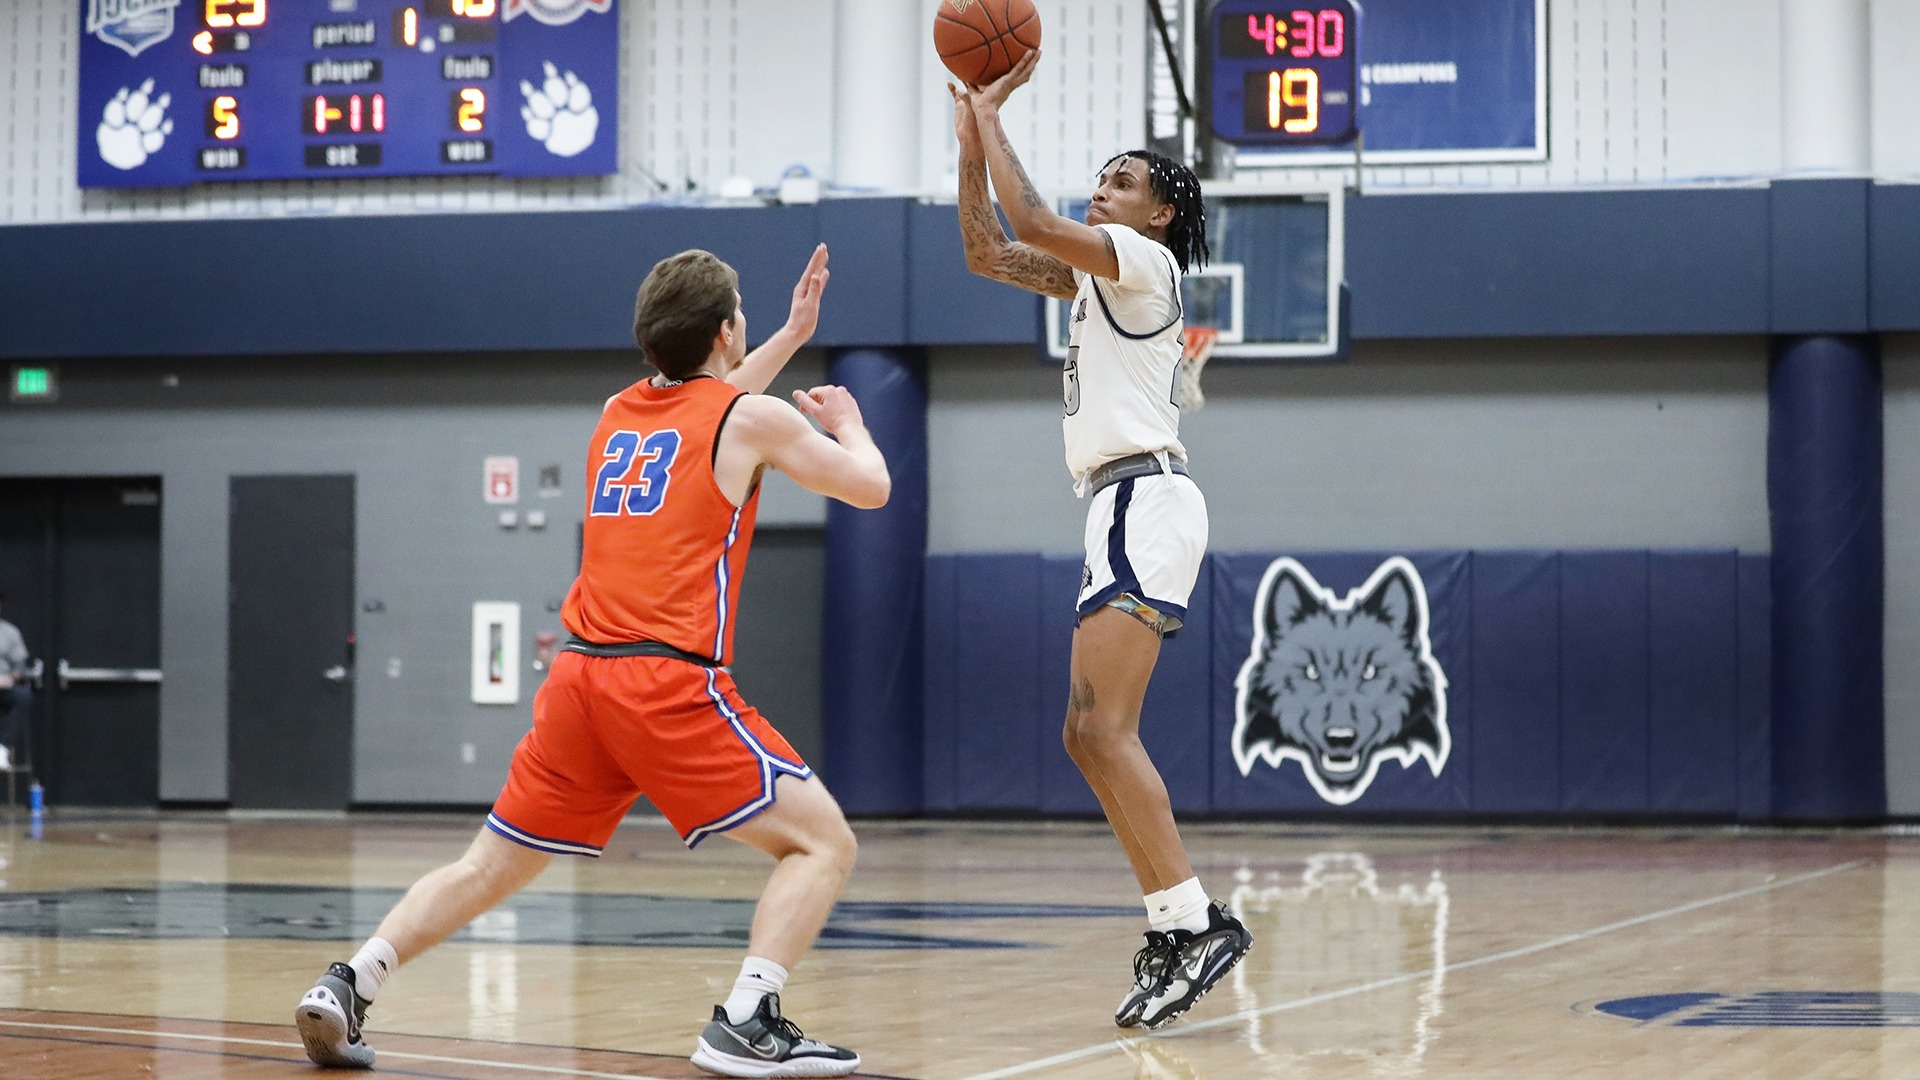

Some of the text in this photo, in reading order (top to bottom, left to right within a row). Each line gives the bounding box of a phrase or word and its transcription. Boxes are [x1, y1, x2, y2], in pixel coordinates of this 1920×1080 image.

[313, 20, 375, 49] period
[1248, 10, 1344, 58] 4:30
[312, 58, 373, 85] player
[213, 95, 239, 139] 5
[458, 88, 485, 132] 2
[1268, 68, 1319, 133] 19
[589, 428, 682, 517] 23
